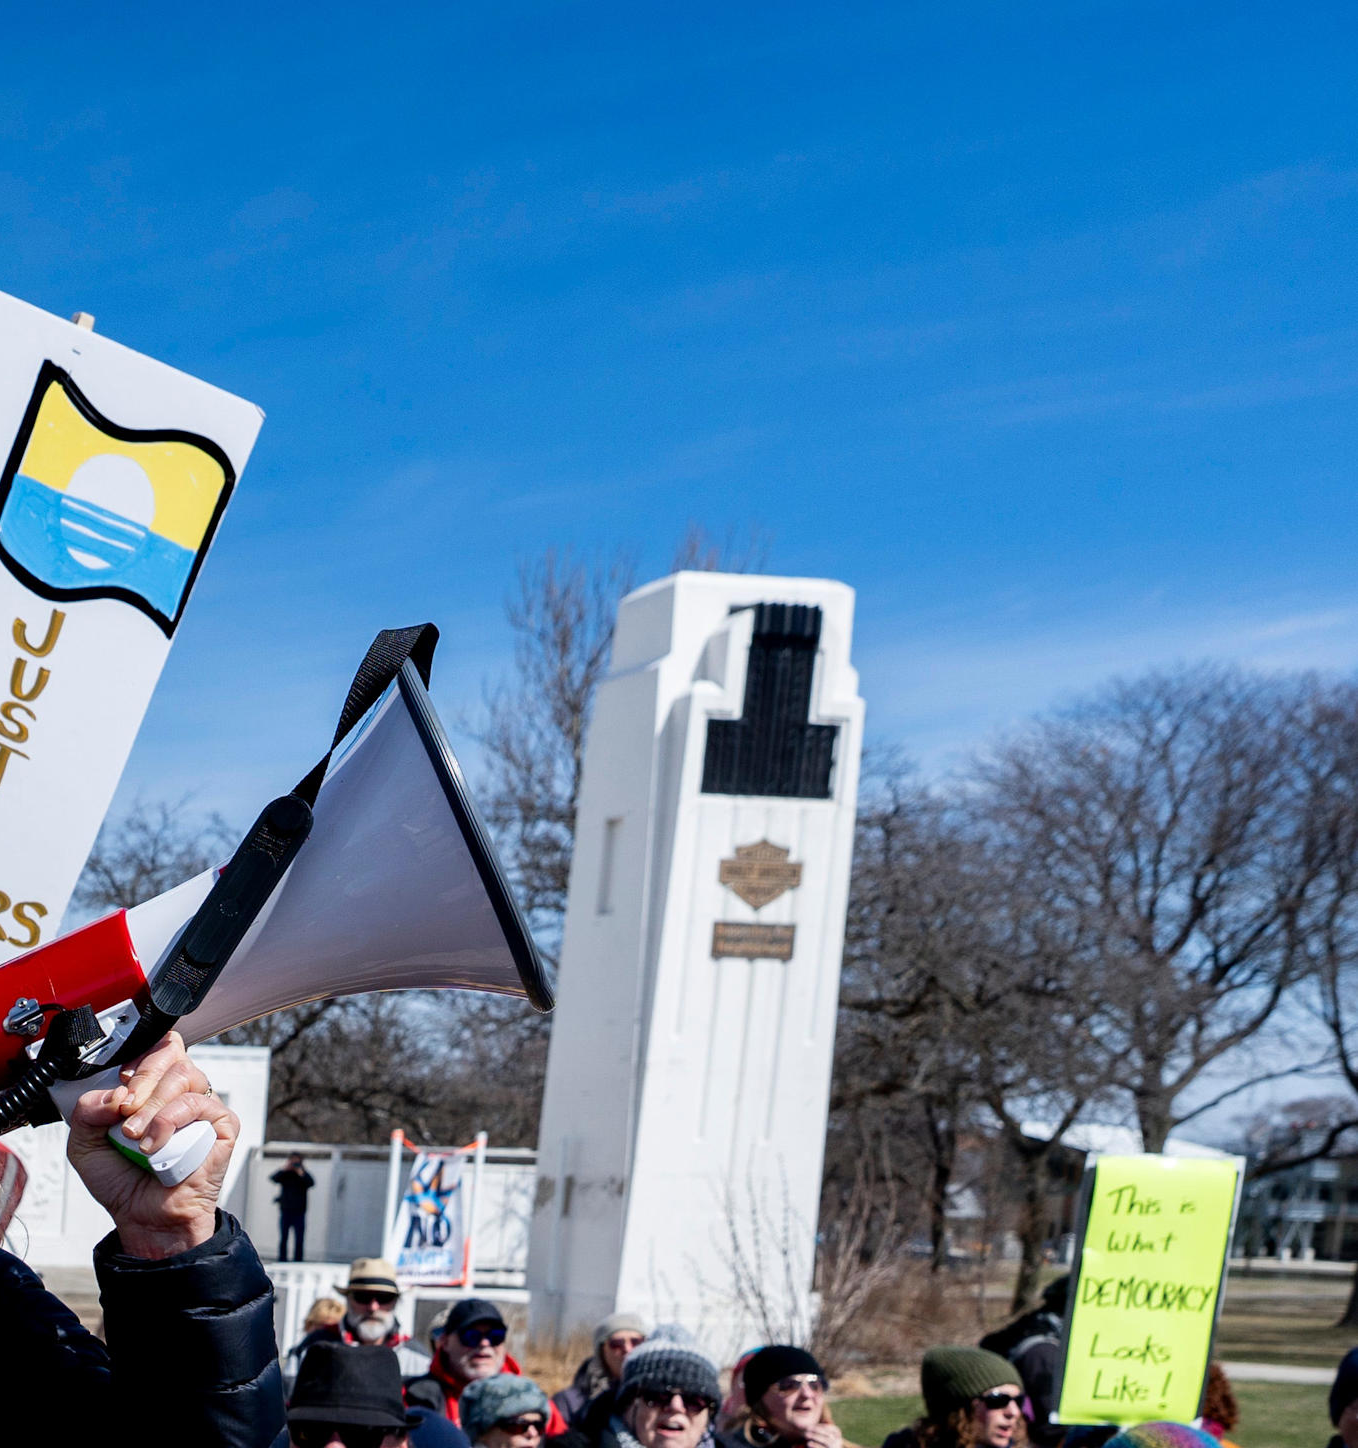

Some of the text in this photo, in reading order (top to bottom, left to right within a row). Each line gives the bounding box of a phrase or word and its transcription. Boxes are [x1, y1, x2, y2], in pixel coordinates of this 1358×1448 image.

[1107, 1184, 1197, 1215] This is
[1081, 1276, 1214, 1313] DEMOCRACY
[1090, 1332, 1171, 1365] Looks
